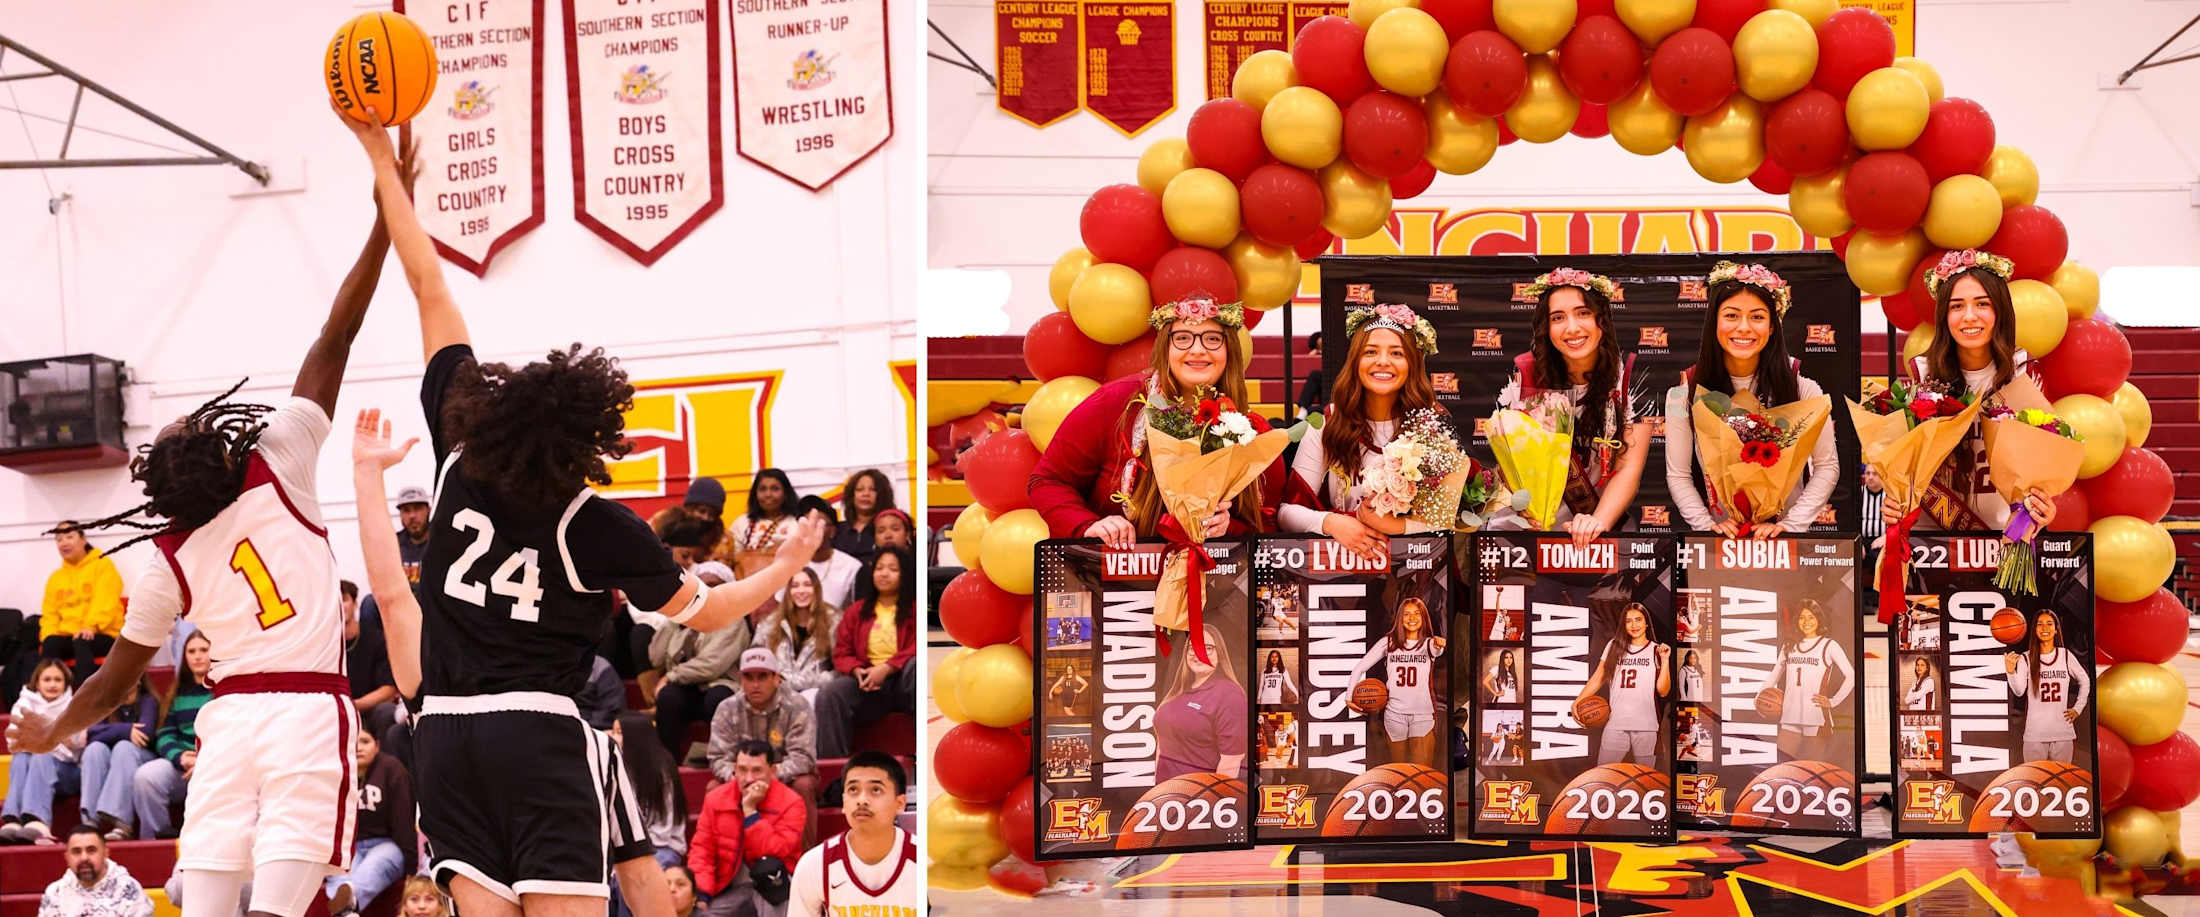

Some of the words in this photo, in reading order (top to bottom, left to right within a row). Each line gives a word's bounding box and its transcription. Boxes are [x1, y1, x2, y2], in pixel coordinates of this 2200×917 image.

[1042, 3, 1076, 15] LEAGUE
[1087, 5, 1120, 16] LEAGUE
[1122, 5, 1168, 16] CHAMPIONS
[1209, 3, 1248, 14] CENTURY
[1251, 4, 1284, 15] LEAGUE
[1295, 7, 1326, 17] LEAGUE
[578, 16, 643, 37] SOUTHERN
[651, 9, 705, 29] SECTION
[767, 16, 849, 39] RUNNER-UP
[1012, 17, 1063, 28] CHAMPIONS
[1215, 16, 1279, 27] CHAMPIONS
[432, 32, 474, 49] THERN
[479, 27, 532, 44] SECTION
[604, 37, 679, 58] CHAMPIONS
[1019, 31, 1057, 43] SOCCER
[1211, 30, 1239, 41] CROSS
[1243, 30, 1283, 42] COUNTRY
[358, 38, 381, 95] NCAA
[762, 96, 865, 126] WRESTLING
[619, 115, 666, 135] BOYS
[448, 128, 496, 152] GIRLS
[795, 134, 834, 153] 1996
[614, 144, 675, 165] CROSS
[447, 156, 498, 182] CROSS
[604, 172, 685, 196] COUNTRY
[438, 185, 507, 212] COUNTRY
[626, 204, 668, 220] 1995
[443, 507, 545, 624] 24
[1105, 552, 1168, 576] VENTU
[1254, 547, 1305, 569] #30
[1408, 542, 1431, 554] Point
[1406, 558, 1433, 570] Guard
[1480, 545, 1528, 568] #12
[1540, 543, 1614, 569] TOMIZH
[1631, 542, 1654, 554] Point
[1629, 557, 1656, 569] Guard
[1676, 543, 1706, 569] #1
[1721, 539, 1791, 569] SUBIA
[1814, 544, 1836, 554] Guard
[1800, 556, 1823, 567] Power
[1823, 556, 1854, 567] Forward
[1956, 539, 2001, 569] LUB
[2043, 540, 2071, 552] Guard
[2041, 556, 2080, 568] Forward
[229, 537, 297, 632] 1
[1307, 583, 1367, 776] LINDSEY
[1396, 666, 1417, 687] 30
[1531, 602, 1590, 761] AMIRA
[1620, 668, 1637, 689] 12
[1720, 585, 1777, 767] AMALIA
[1796, 667, 1802, 687] 1
[1947, 591, 2010, 775] CAMILA
[1102, 590, 1156, 789] MADISON
[2040, 682, 2062, 702] 22
[1342, 788, 1444, 821] 2026
[1565, 788, 1667, 821] 2026
[1751, 783, 1851, 817] 2026
[1988, 785, 2091, 818] 2026
[1132, 797, 1239, 833] 2026
